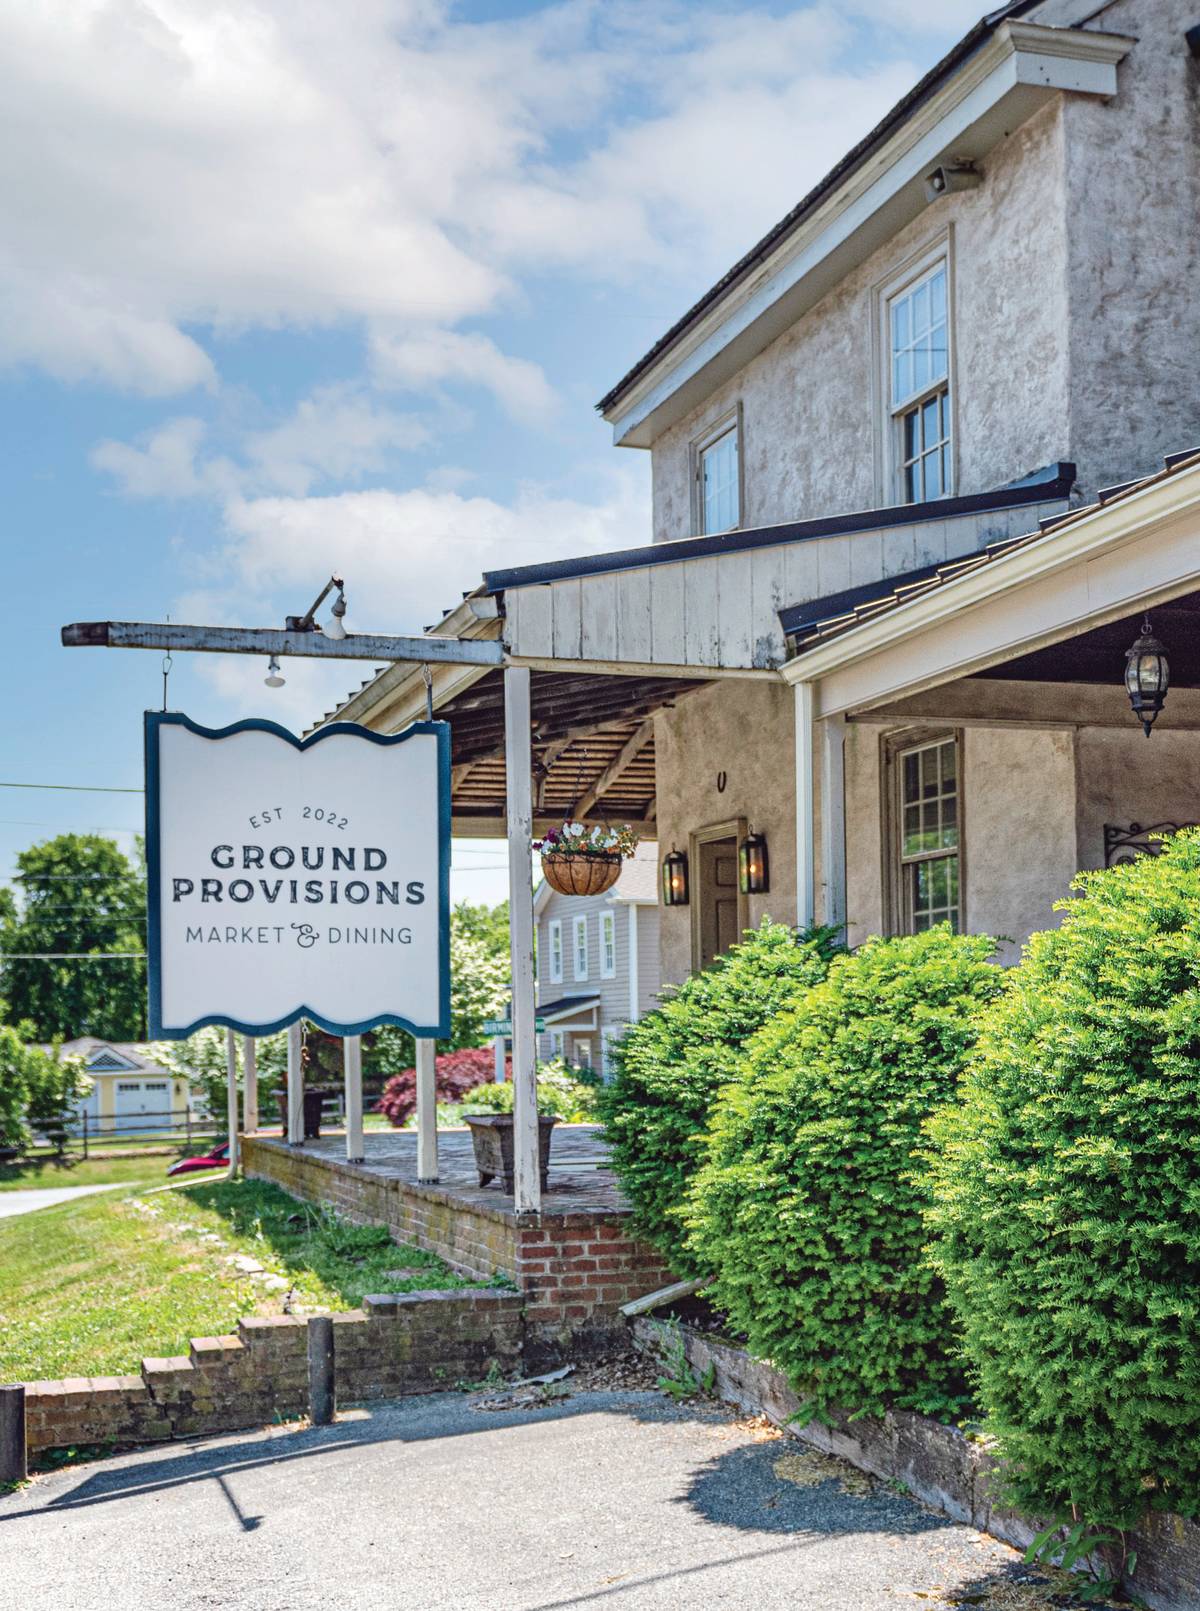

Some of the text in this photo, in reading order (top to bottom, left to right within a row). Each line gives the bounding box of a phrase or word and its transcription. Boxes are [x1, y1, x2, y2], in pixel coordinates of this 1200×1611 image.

[249, 806, 348, 830] EST 2022
[211, 845, 388, 872] GROUND
[172, 878, 426, 905] PROVISIONS
[186, 922, 412, 948] MARKET & DINING
[484, 1022, 512, 1034] BIRMIN
